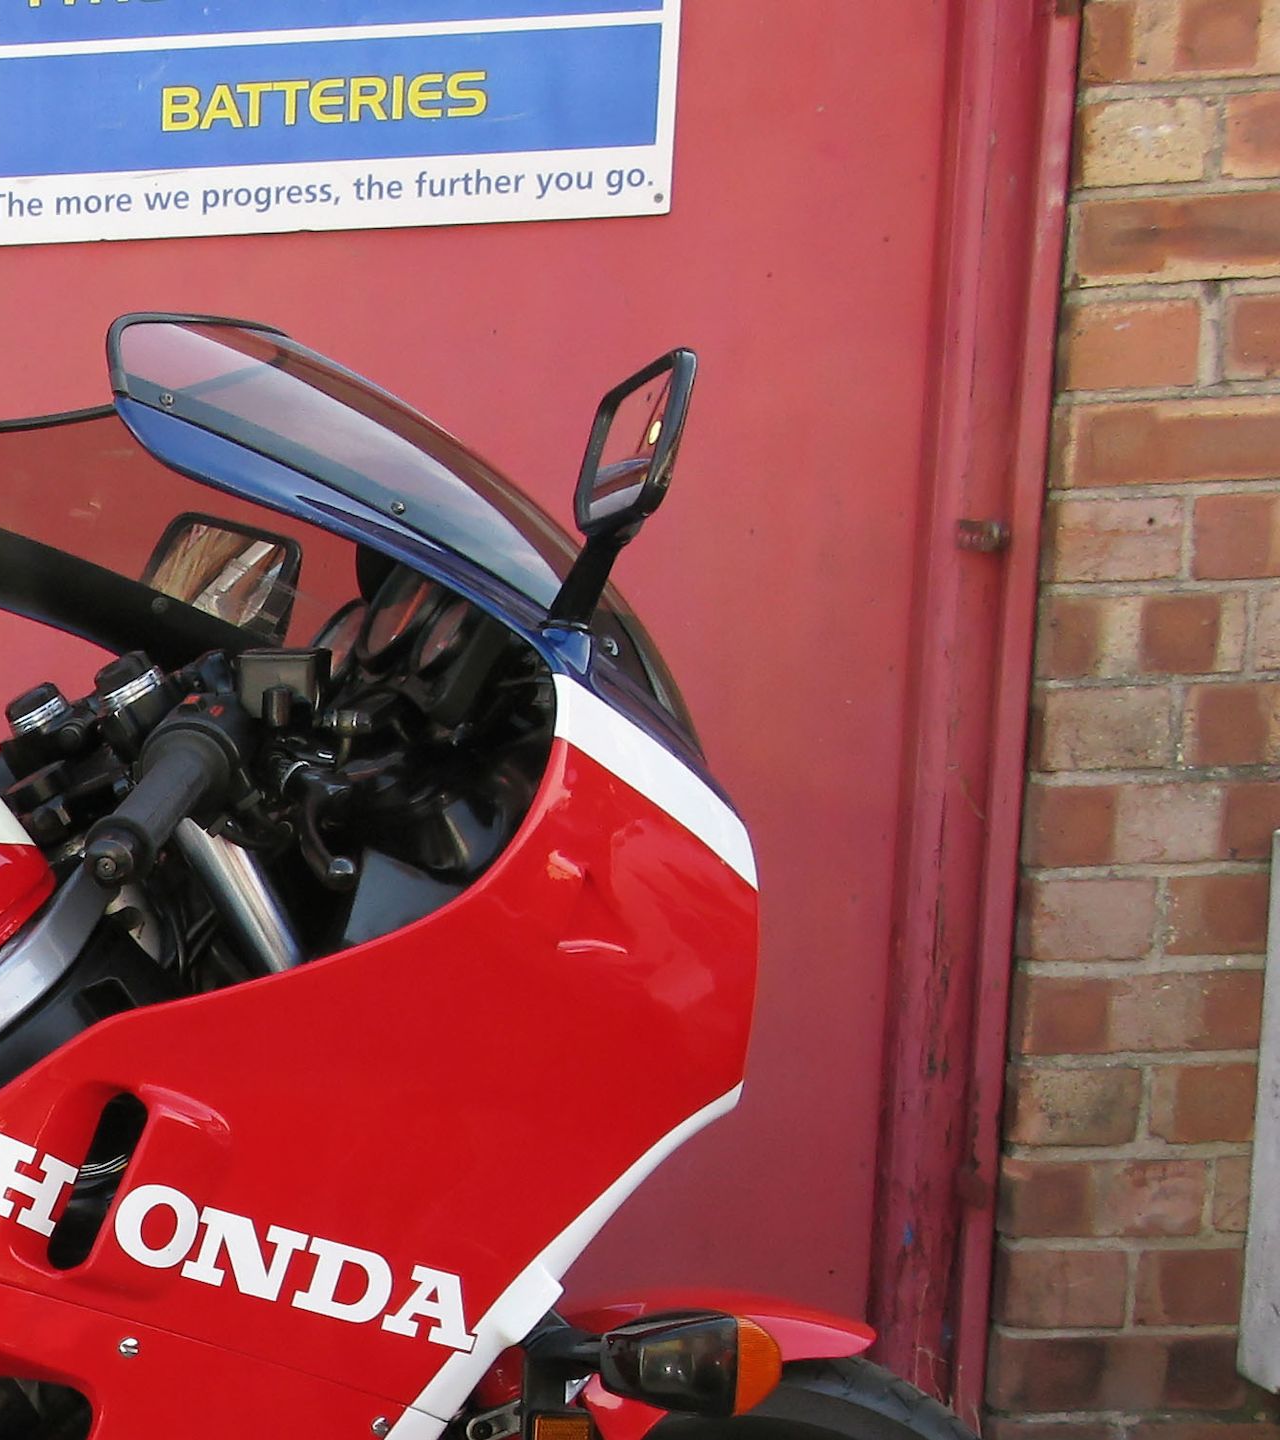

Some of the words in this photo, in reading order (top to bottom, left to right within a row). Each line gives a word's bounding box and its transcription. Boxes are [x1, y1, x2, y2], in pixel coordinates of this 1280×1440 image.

[160, 70, 488, 133] BATTERIES
[55, 192, 133, 216] more
[144, 189, 190, 211] we
[201, 183, 341, 216] progress,
[353, 174, 403, 201] the
[414, 168, 526, 198] further
[535, 169, 594, 199] you
[605, 167, 654, 196] go.
